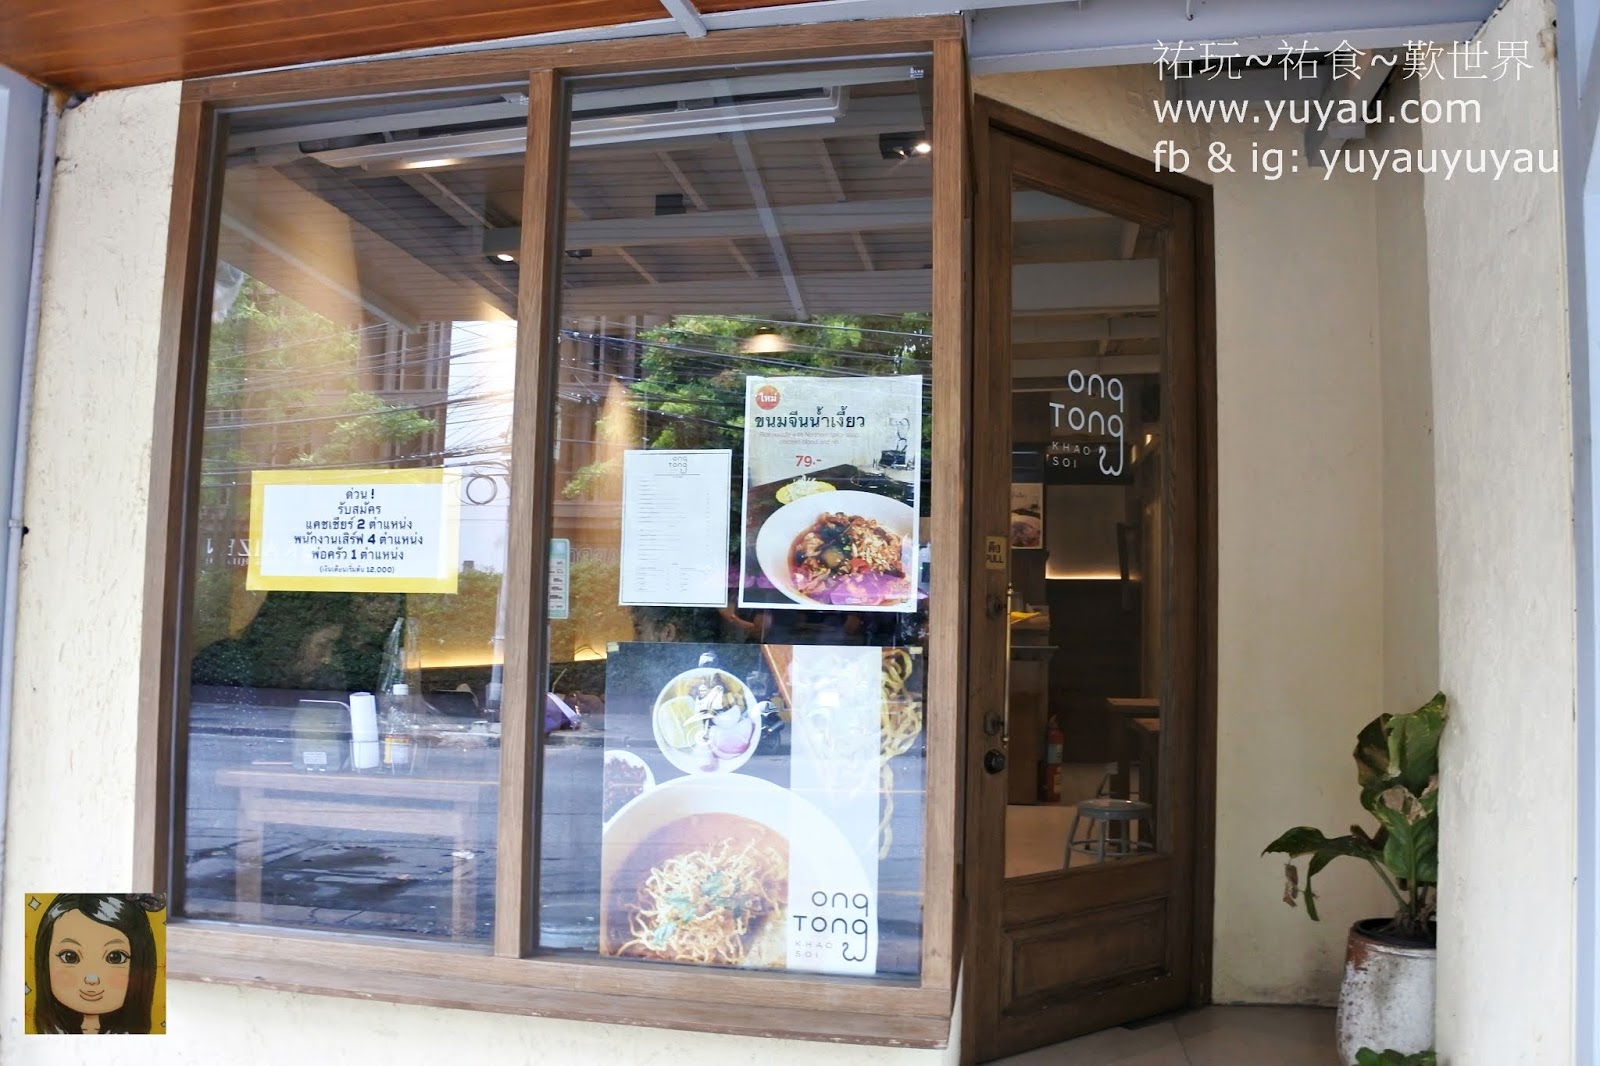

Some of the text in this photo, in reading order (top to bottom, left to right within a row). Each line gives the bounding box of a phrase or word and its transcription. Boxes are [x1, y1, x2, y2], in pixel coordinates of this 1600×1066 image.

[755, 406, 865, 428] ขนมจีนน้ำเงี้ยว
[1052, 441, 1090, 456] KHAO
[1052, 456, 1077, 468] SOI
[346, 487, 367, 499] ด่วน
[338, 501, 381, 515] รับสมัคร
[305, 516, 412, 529] แคชเชียร์ 2 ตำแหน่ง
[294, 531, 423, 545] พนักงานเสิร์ฟ 4 ตำแหน่ง
[312, 546, 404, 560] พ่อครัว 1 ตำแหน่ง
[795, 941, 833, 949] KHAO
